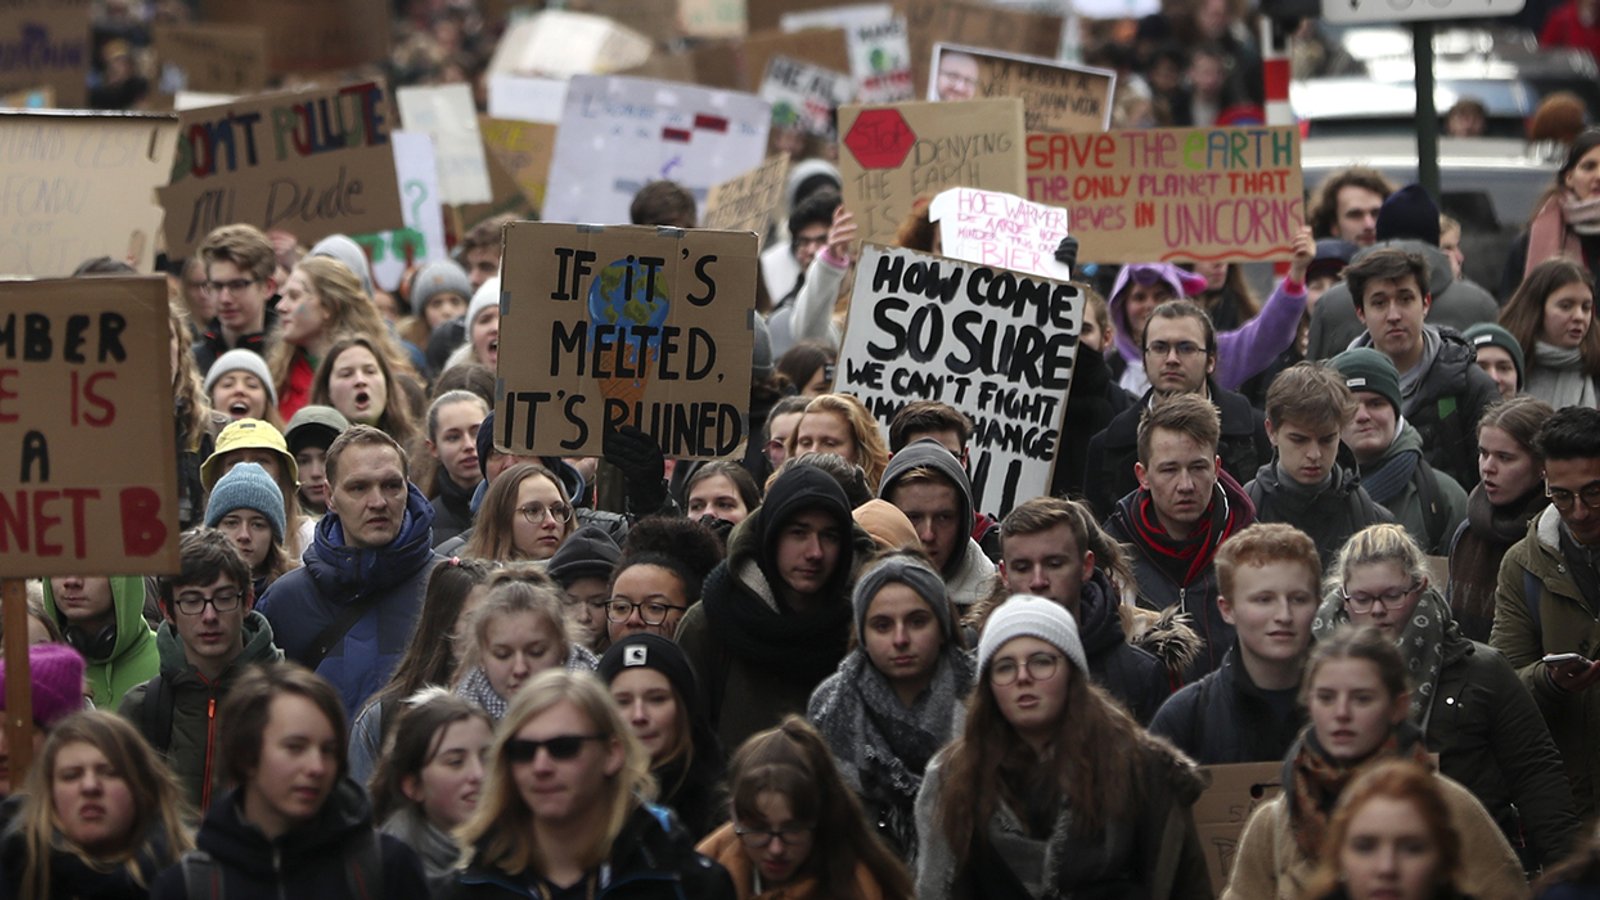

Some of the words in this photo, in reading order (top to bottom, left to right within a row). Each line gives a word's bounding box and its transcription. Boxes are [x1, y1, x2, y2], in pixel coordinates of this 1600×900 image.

[271, 83, 388, 161] POLLUTE
[854, 120, 908, 150] STOP
[914, 133, 1013, 168] DENYING
[264, 166, 366, 229] Dude
[854, 171, 893, 201] THE
[911, 162, 982, 196] EARTH
[957, 188, 1004, 216] HOE
[1073, 175, 1132, 201] ONLY
[1227, 169, 1291, 196] THAT
[551, 247, 597, 301] IF
[980, 241, 1053, 278] BIER
[872, 255, 964, 305] HOW
[966, 267, 1079, 329] COME
[549, 320, 725, 384] MELTED,
[866, 297, 944, 363] SO
[944, 310, 1079, 390] SURE
[70, 369, 118, 428] IS
[503, 389, 589, 450] IT'S
[846, 358, 885, 390] WE
[890, 367, 972, 404] CAN'T
[977, 381, 1060, 428] FIGHT
[20, 430, 50, 483] A
[964, 411, 1059, 462] HANGE
[0, 487, 101, 560] NET
[119, 485, 168, 558] B
